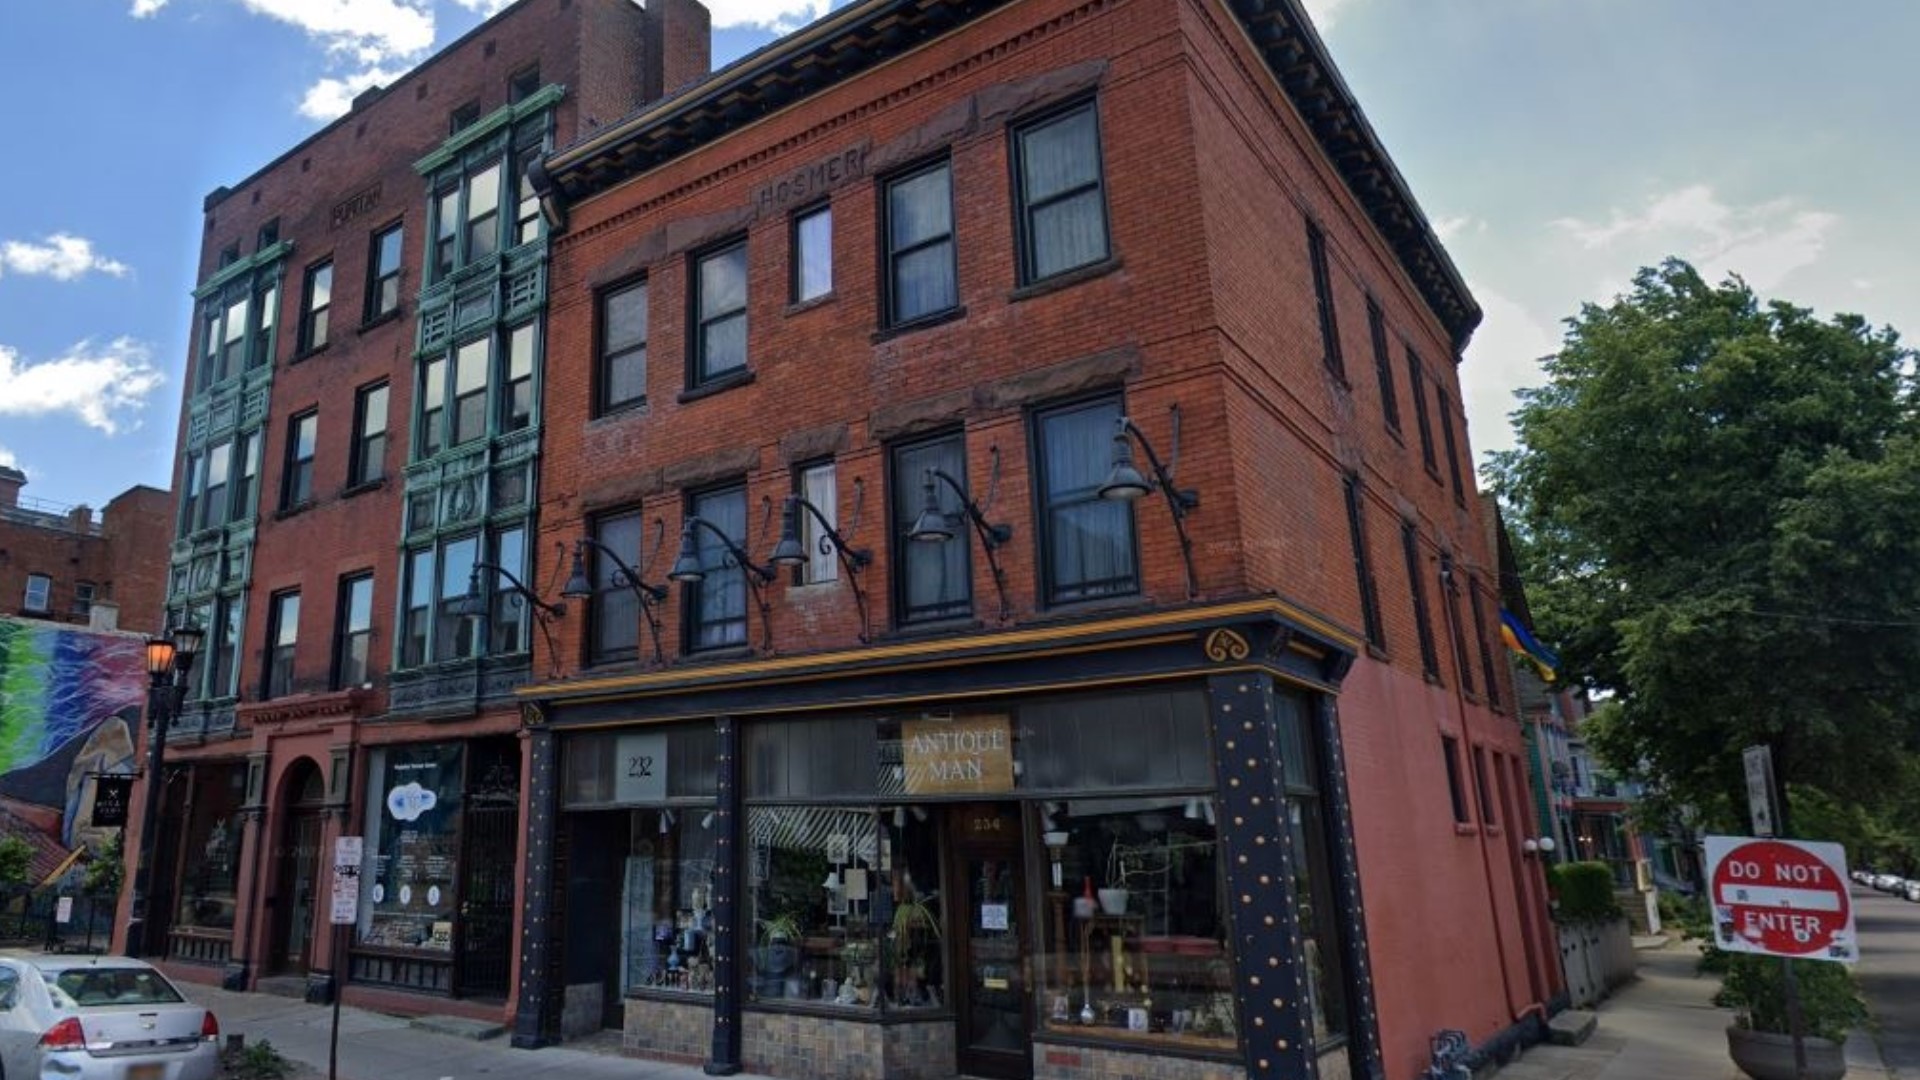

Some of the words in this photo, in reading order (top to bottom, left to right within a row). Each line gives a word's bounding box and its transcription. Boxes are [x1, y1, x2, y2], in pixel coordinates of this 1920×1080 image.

[911, 728, 1005, 755] ANTIQUE
[628, 755, 653, 777] 232
[929, 759, 983, 782] MAN
[1728, 860, 1761, 879] DO
[1775, 864, 1823, 883] NOT
[1743, 910, 1822, 935] ENTER
